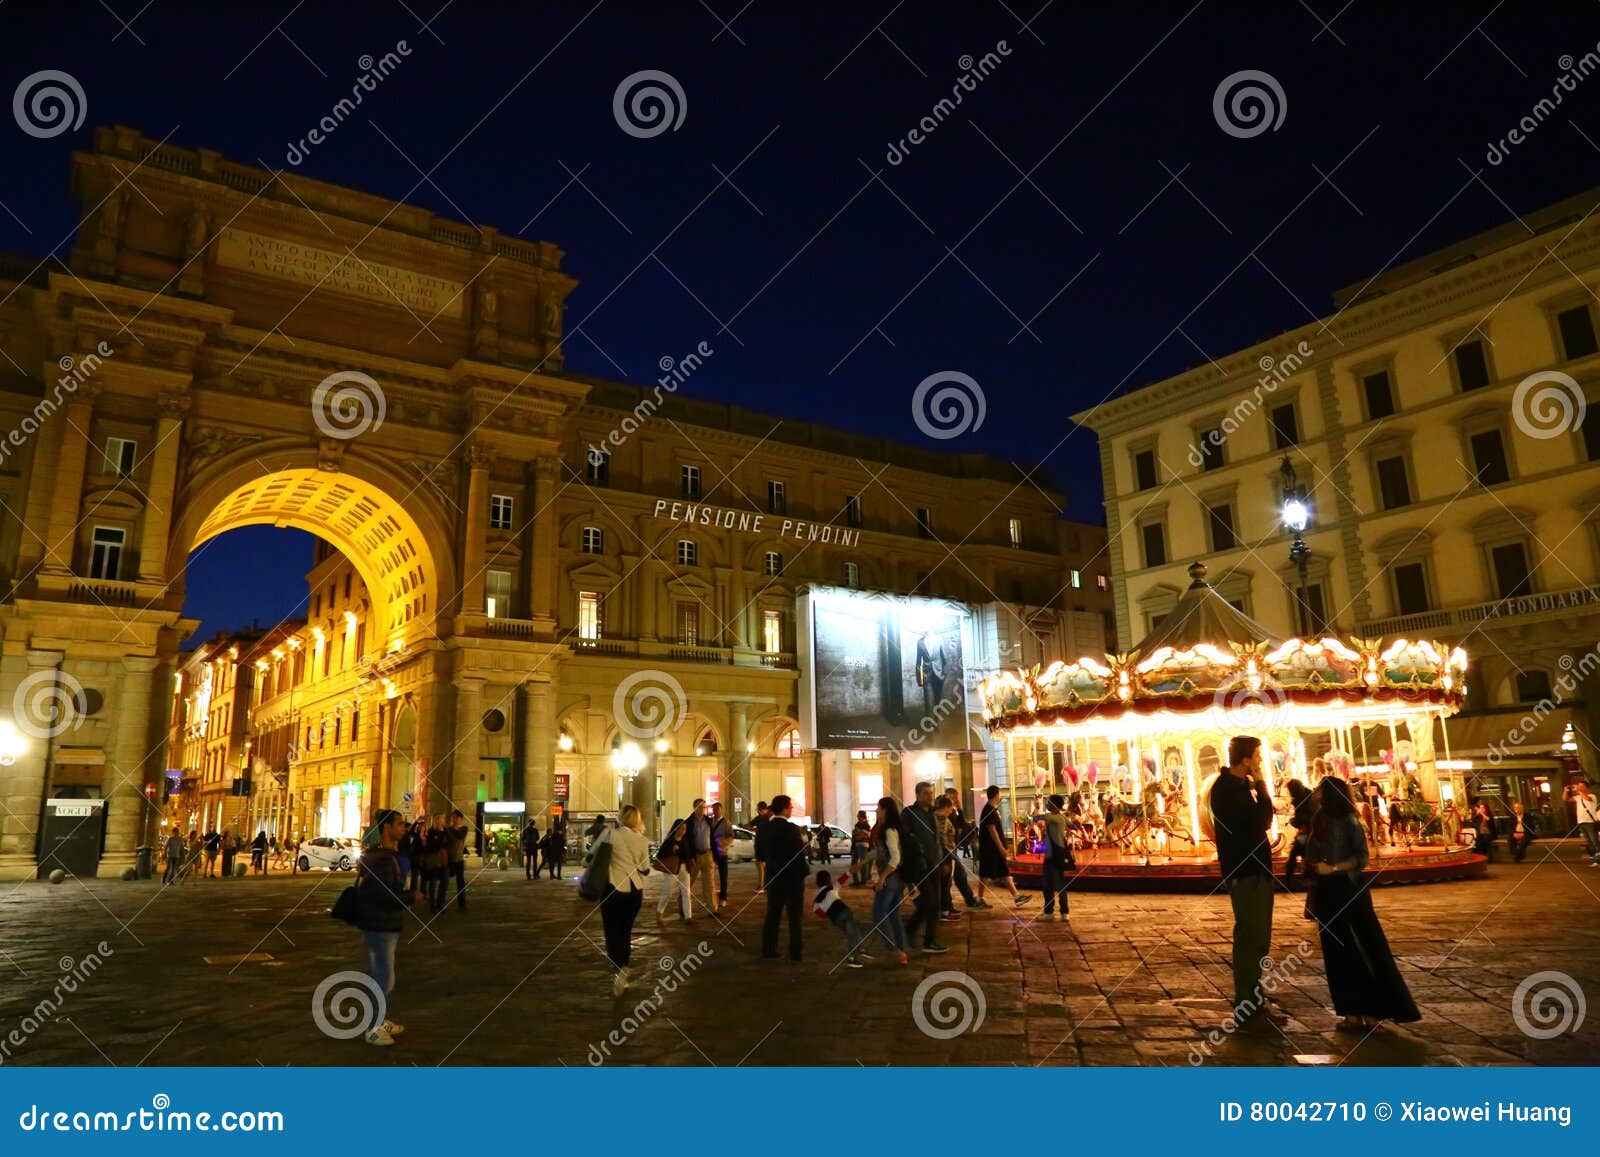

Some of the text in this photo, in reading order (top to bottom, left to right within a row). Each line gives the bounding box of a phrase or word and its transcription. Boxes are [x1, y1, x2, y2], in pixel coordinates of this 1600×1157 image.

[654, 499, 861, 547] PENSIONE PENDINI
[1508, 589, 1599, 615] FONDIARIA
[57, 807, 91, 815] VOGUE
